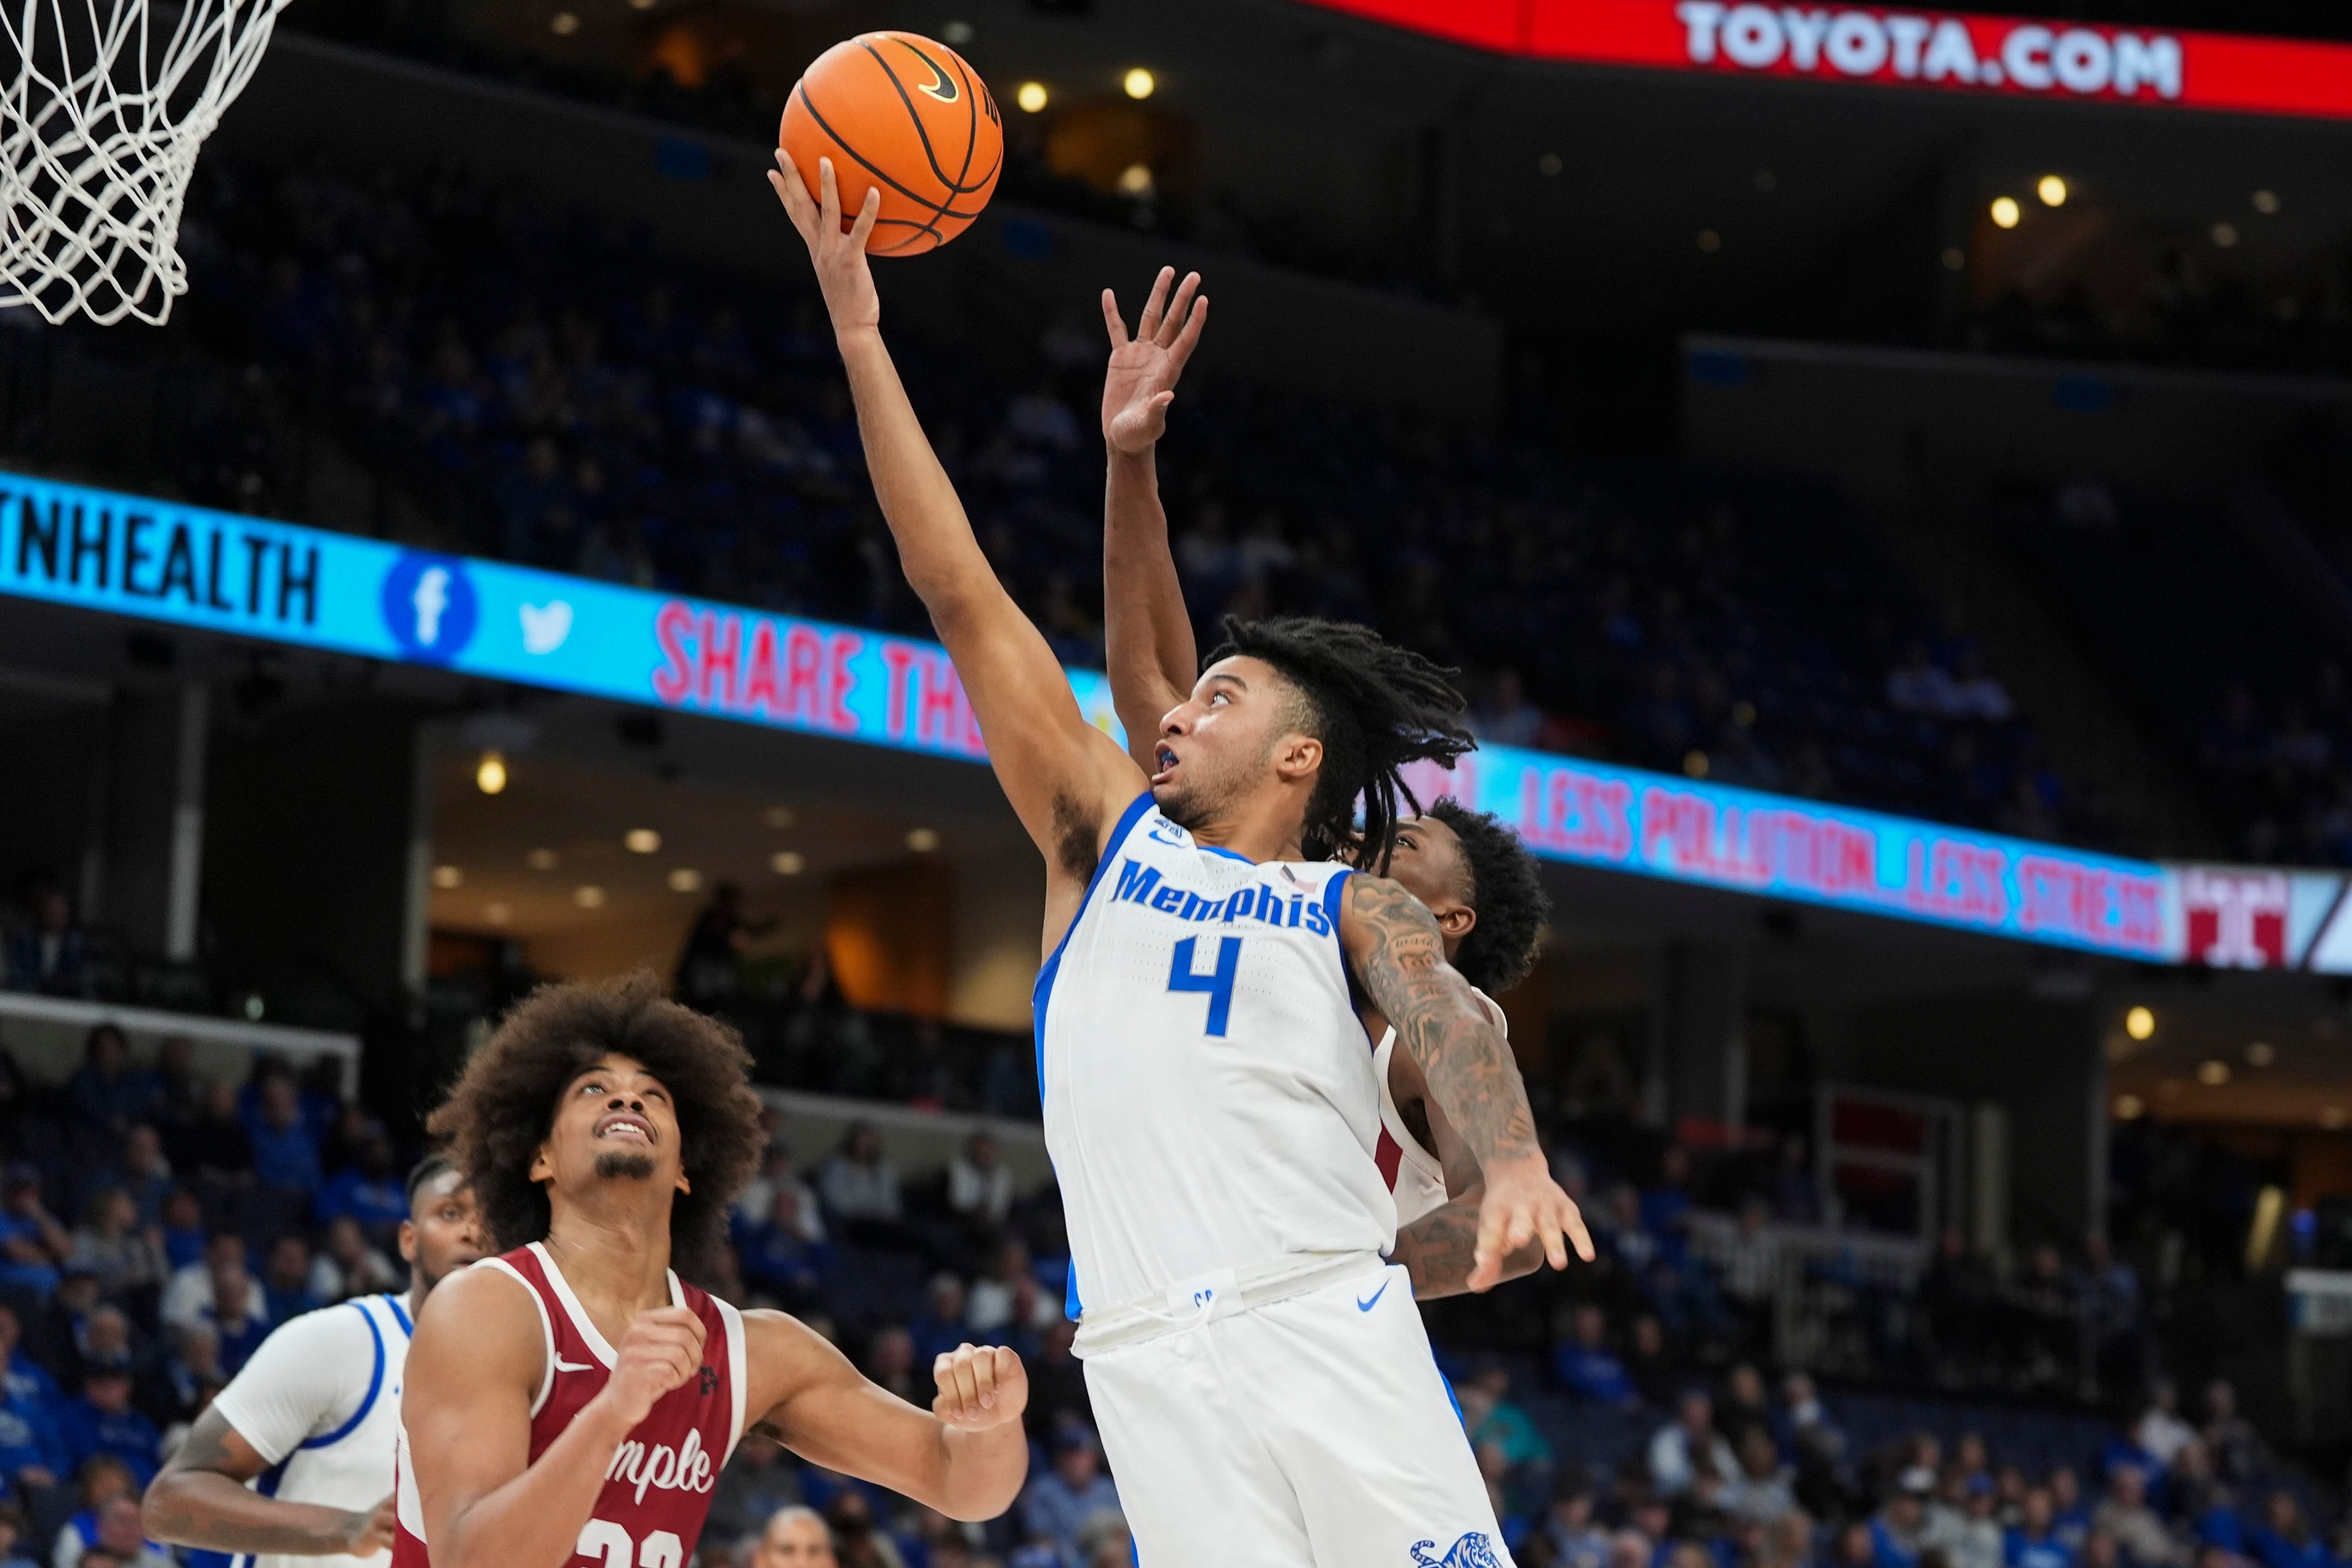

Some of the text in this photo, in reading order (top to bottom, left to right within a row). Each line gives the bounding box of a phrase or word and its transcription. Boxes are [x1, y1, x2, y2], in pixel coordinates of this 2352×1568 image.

[1678, 1, 2181, 99] TOYOTA.COM
[652, 600, 864, 734] SHARE
[1108, 856, 1331, 938] Memphis
[1166, 934, 1244, 1039] 4
[604, 1427, 715, 1506] mple
